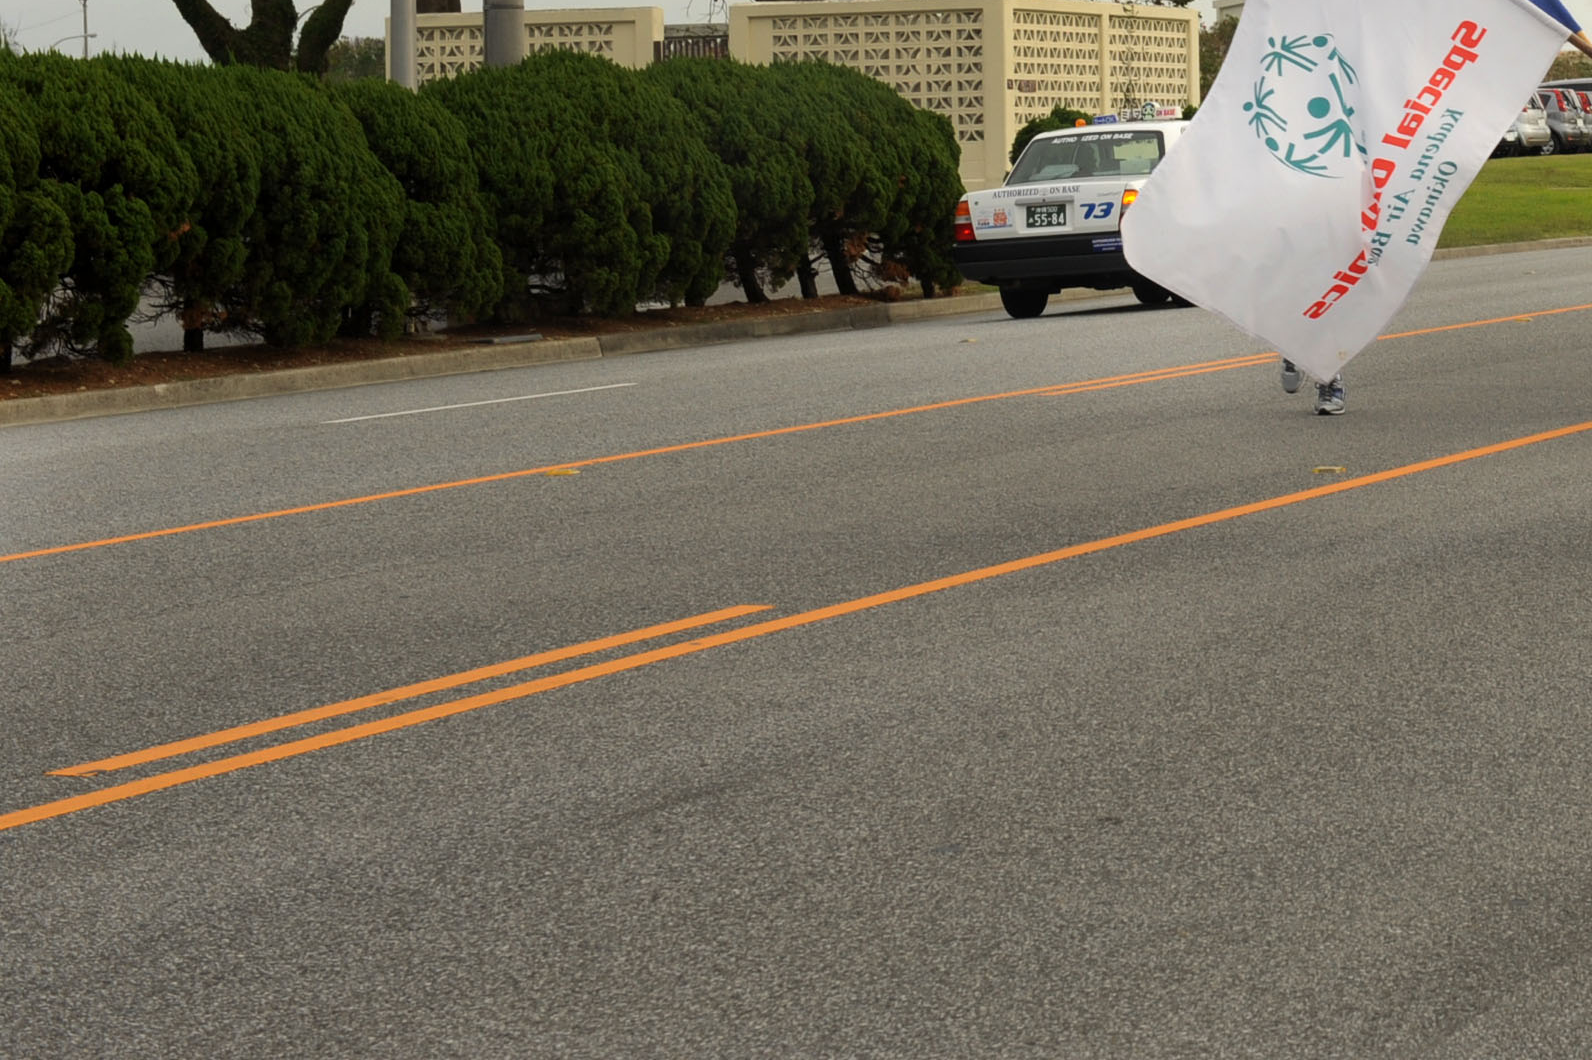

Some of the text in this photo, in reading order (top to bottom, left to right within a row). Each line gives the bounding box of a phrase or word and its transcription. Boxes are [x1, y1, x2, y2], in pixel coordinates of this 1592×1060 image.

[1100, 133, 1113, 141] ON
[1112, 132, 1134, 140] BASE
[992, 185, 1081, 199] AUTHORIZED ON BASE
[1080, 201, 1115, 220] 73
[1034, 212, 1065, 226] 55-84
